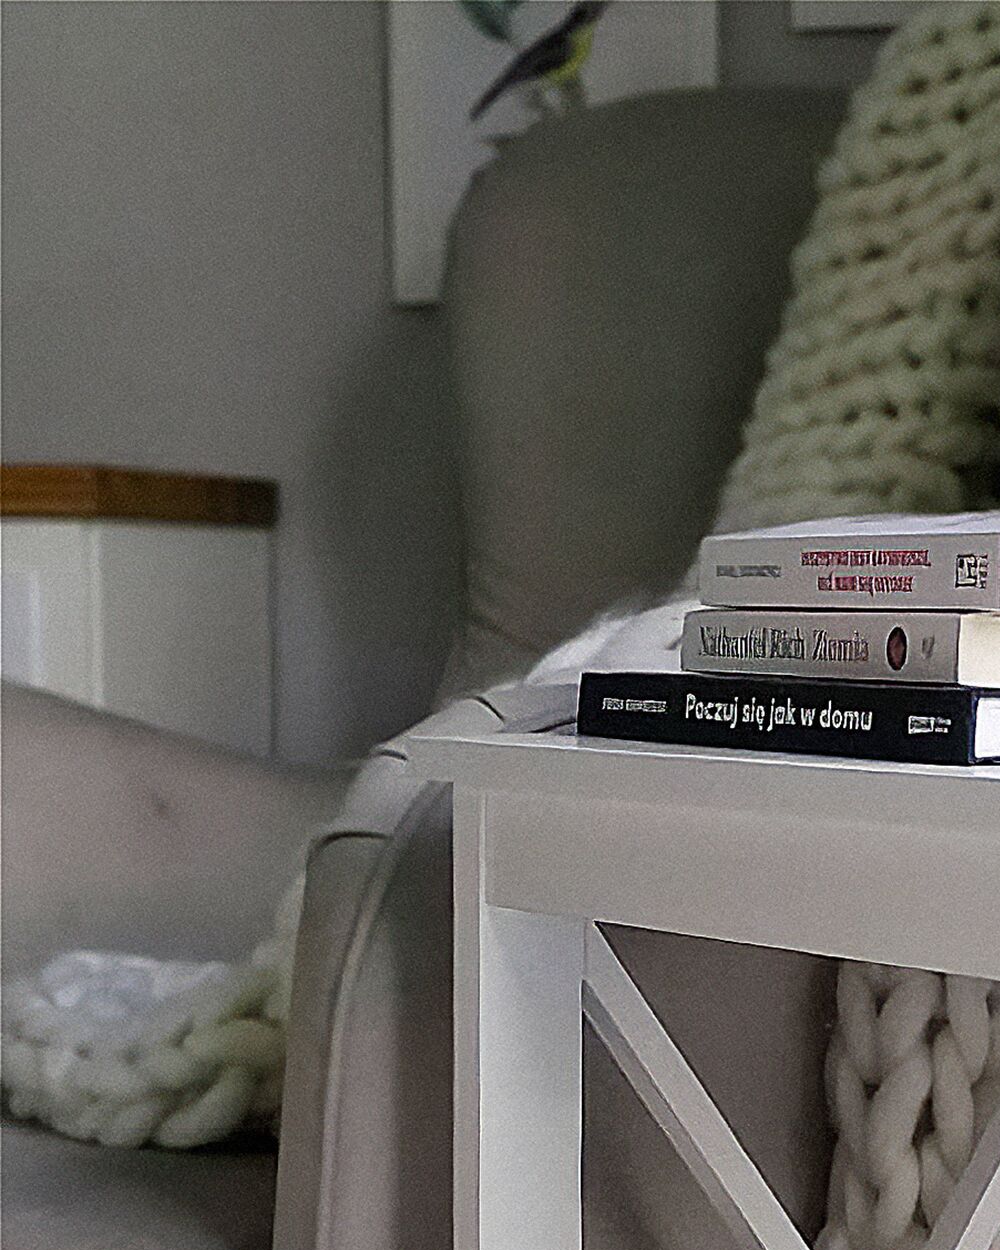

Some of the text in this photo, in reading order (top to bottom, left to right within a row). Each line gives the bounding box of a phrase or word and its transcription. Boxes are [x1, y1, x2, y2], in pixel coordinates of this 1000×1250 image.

[685, 693, 739, 729] Poczuj
[742, 697, 766, 731] się
[766, 698, 797, 732] jak
[800, 707, 817, 727] w
[819, 700, 873, 731] domu
